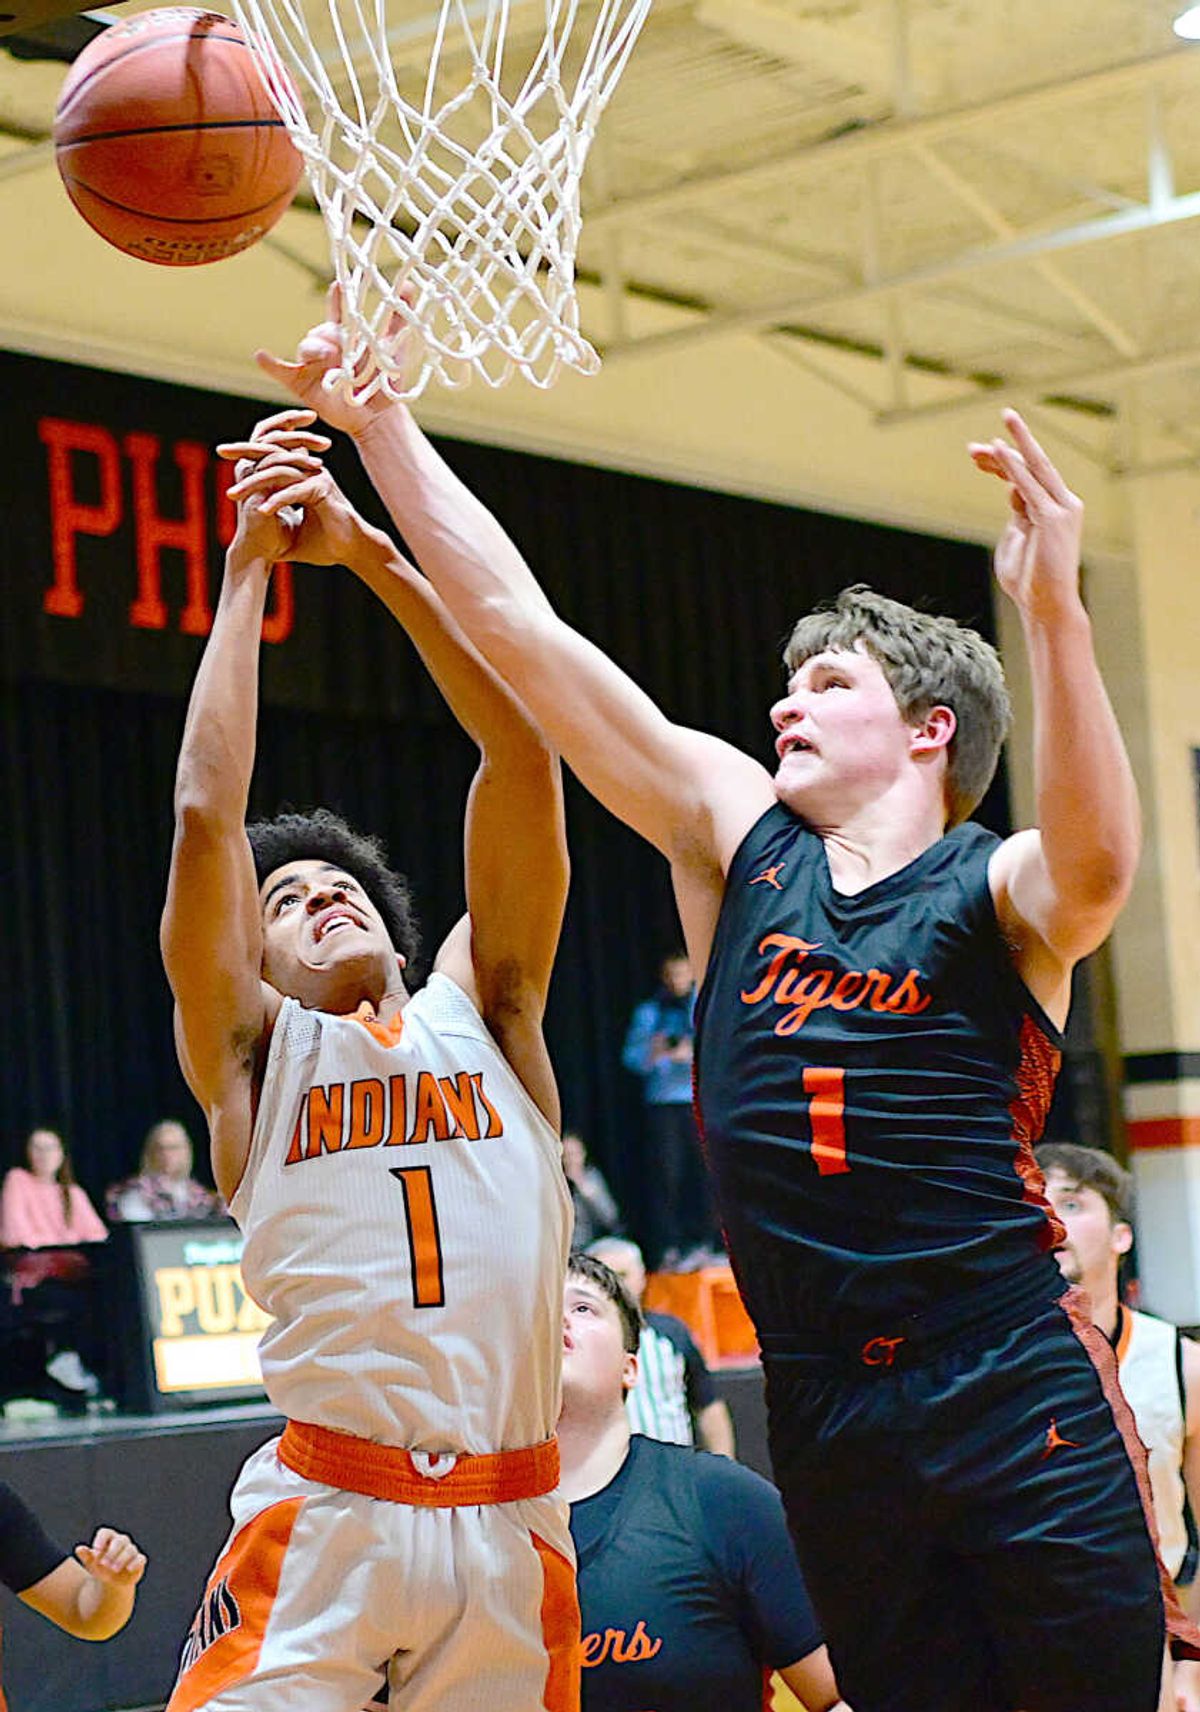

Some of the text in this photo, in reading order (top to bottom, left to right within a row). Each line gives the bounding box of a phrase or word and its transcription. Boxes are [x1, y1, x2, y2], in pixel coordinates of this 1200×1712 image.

[741, 932, 932, 1036] Tigers
[803, 1067, 851, 1176] 1
[389, 1165, 445, 1308] 1
[862, 1337, 905, 1367] CT
[580, 1620, 663, 1668] ers
